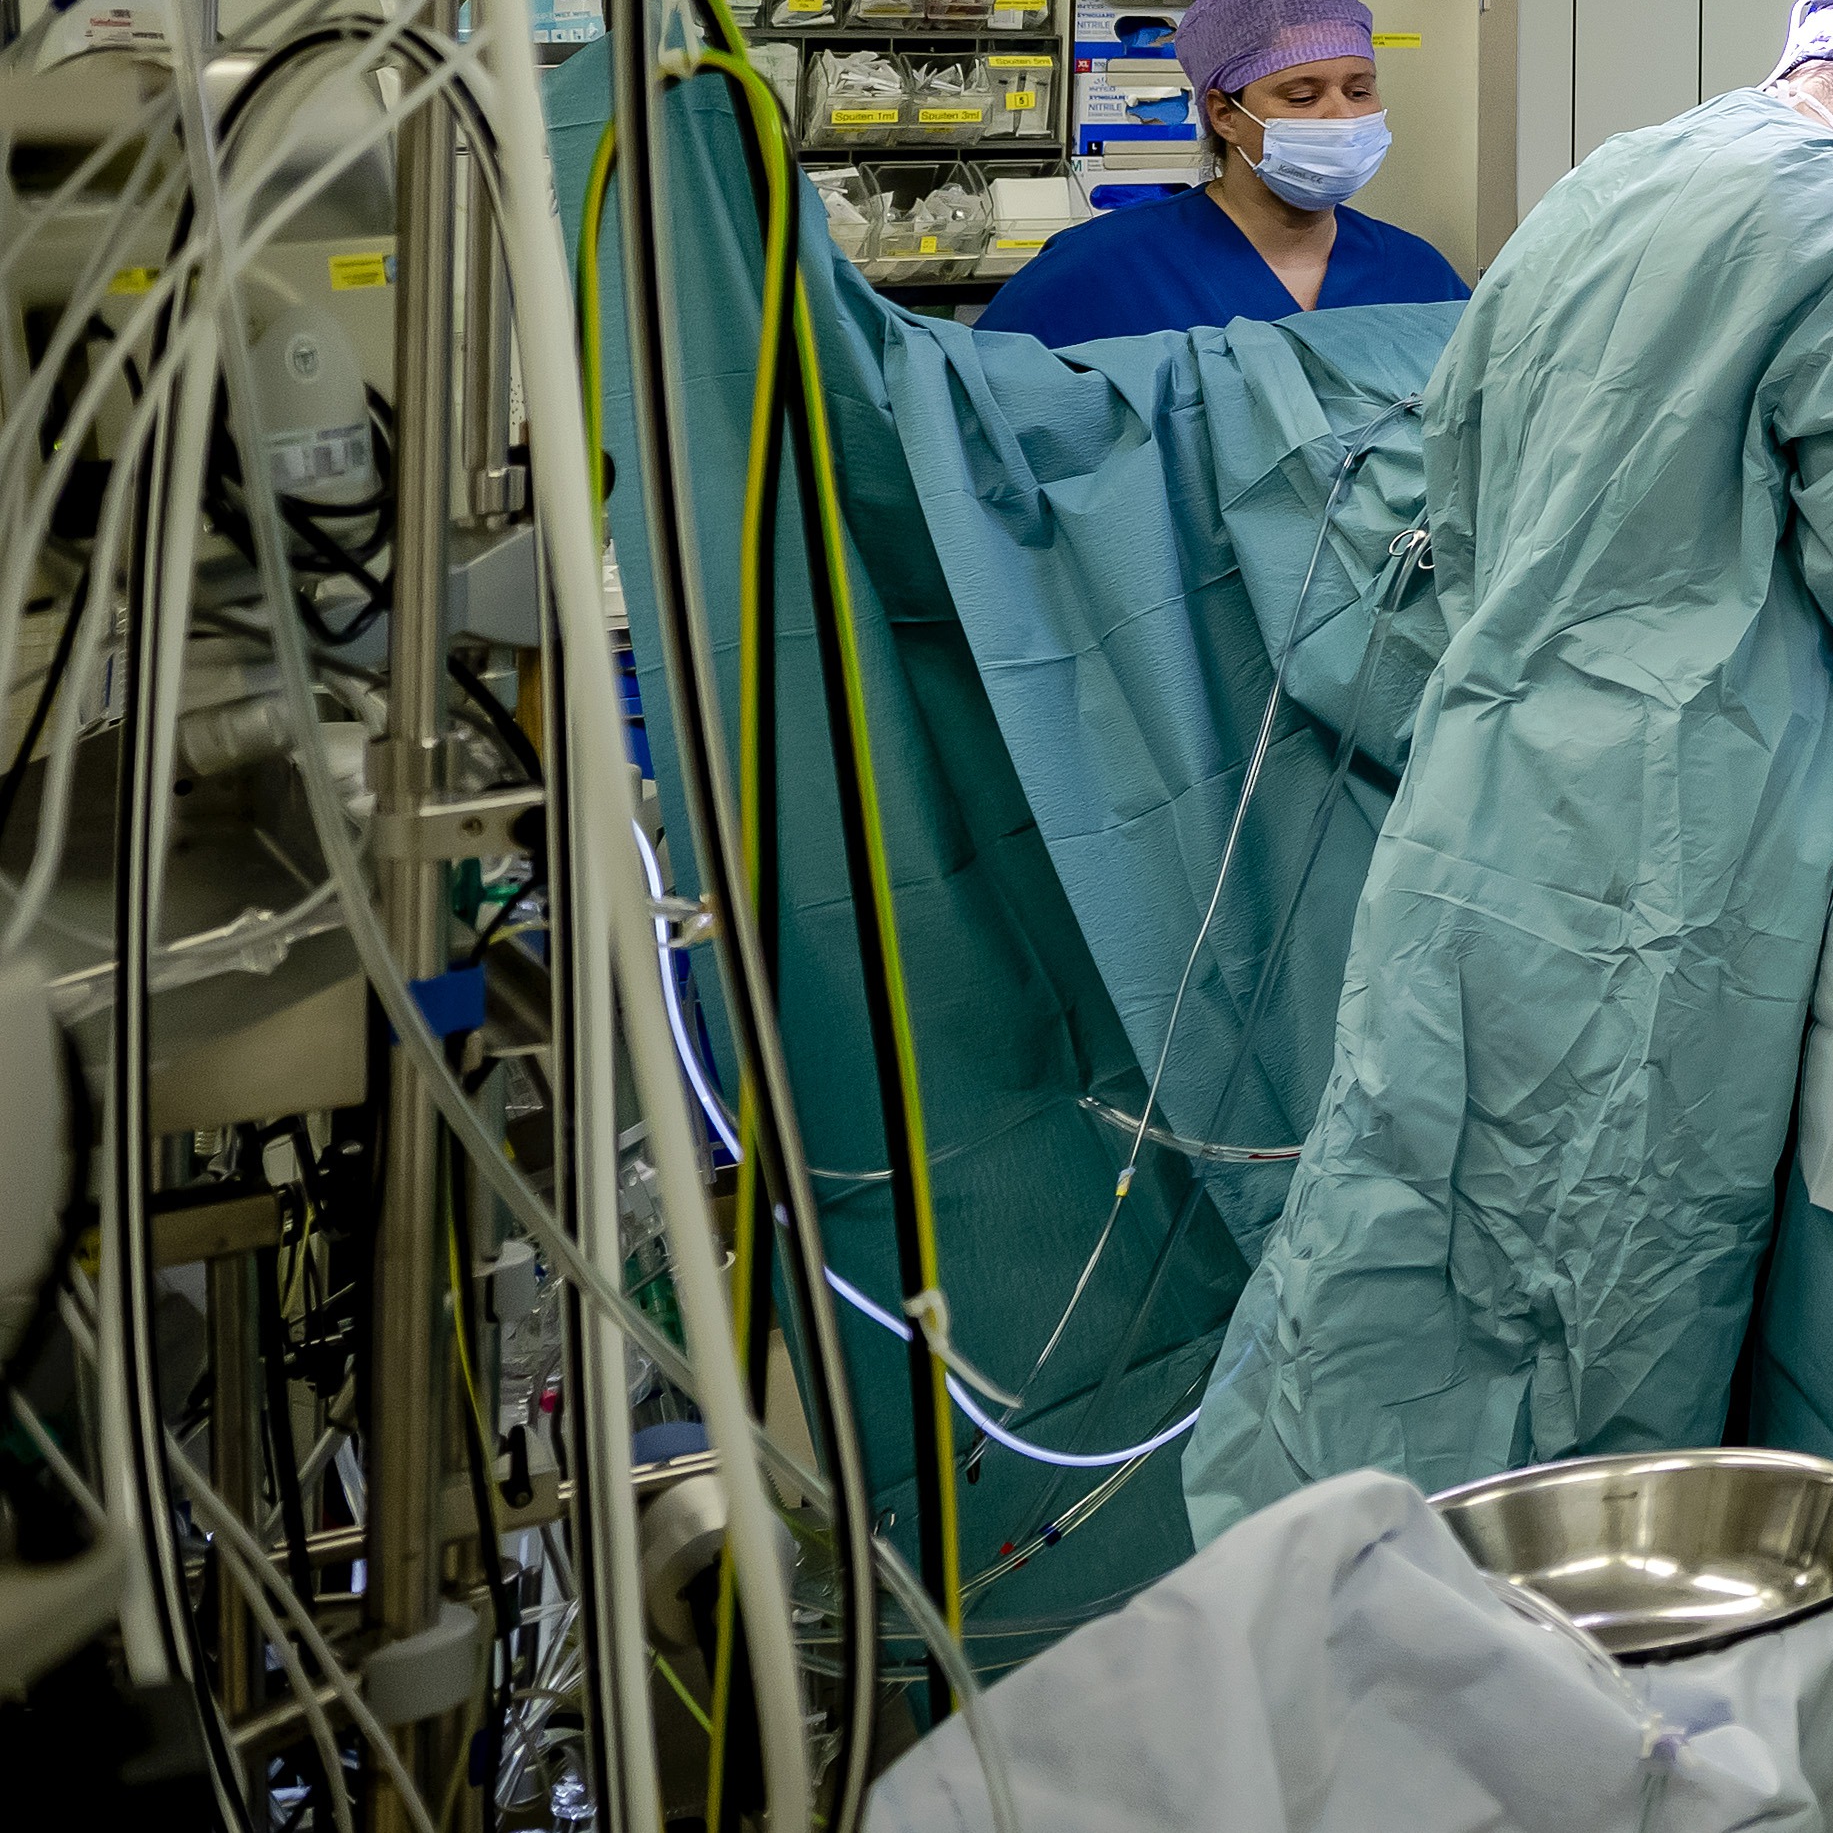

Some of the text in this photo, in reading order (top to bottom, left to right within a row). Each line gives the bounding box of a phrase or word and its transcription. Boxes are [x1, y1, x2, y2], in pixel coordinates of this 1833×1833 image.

[1077, 60, 1089, 68] XL
[1088, 103, 1121, 111] NITRILE
[834, 111, 896, 122] Spuiten 1ml
[920, 110, 980, 121] Spuiten 3ml
[1091, 142, 1097, 150] L
[1278, 164, 1306, 179] Kolmi
